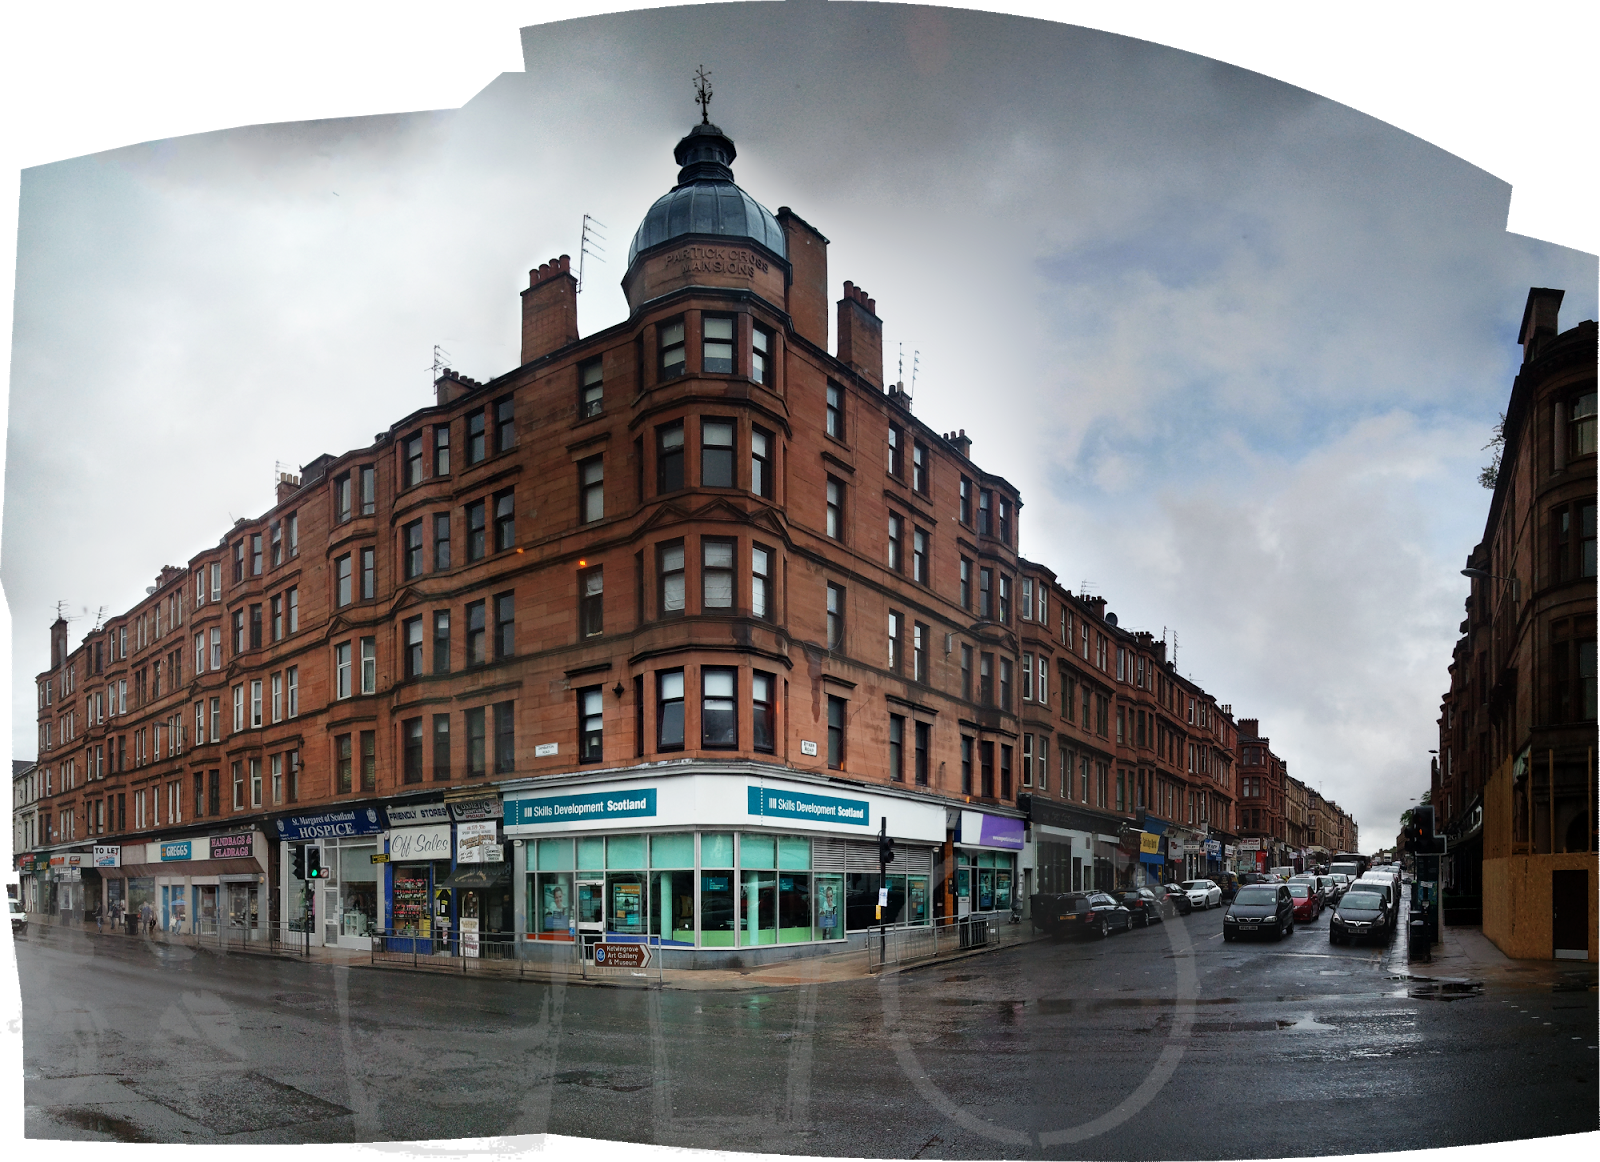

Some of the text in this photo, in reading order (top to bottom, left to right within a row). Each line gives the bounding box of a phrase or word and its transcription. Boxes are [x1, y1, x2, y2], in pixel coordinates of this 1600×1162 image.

[665, 247, 769, 274] PARTICK CROSS
[682, 261, 755, 278] MANSIONS
[388, 808, 447, 821] FRIENDLY STORES
[533, 798, 647, 817] Skills Development Scotland
[778, 798, 864, 818] Skills Development Scotland
[299, 815, 324, 826] Margaret
[324, 814, 331, 822] of
[331, 811, 356, 822] Scotland
[298, 823, 355, 838] HOSPICE
[211, 835, 252, 847] HANDBAGS &
[391, 833, 448, 857] Off Sales
[95, 847, 119, 855] TO LET
[166, 844, 188, 857] GREGGS
[214, 847, 249, 858] GLADRAGS
[606, 945, 639, 953] Kelvingrove
[617, 952, 639, 960] Gallery
